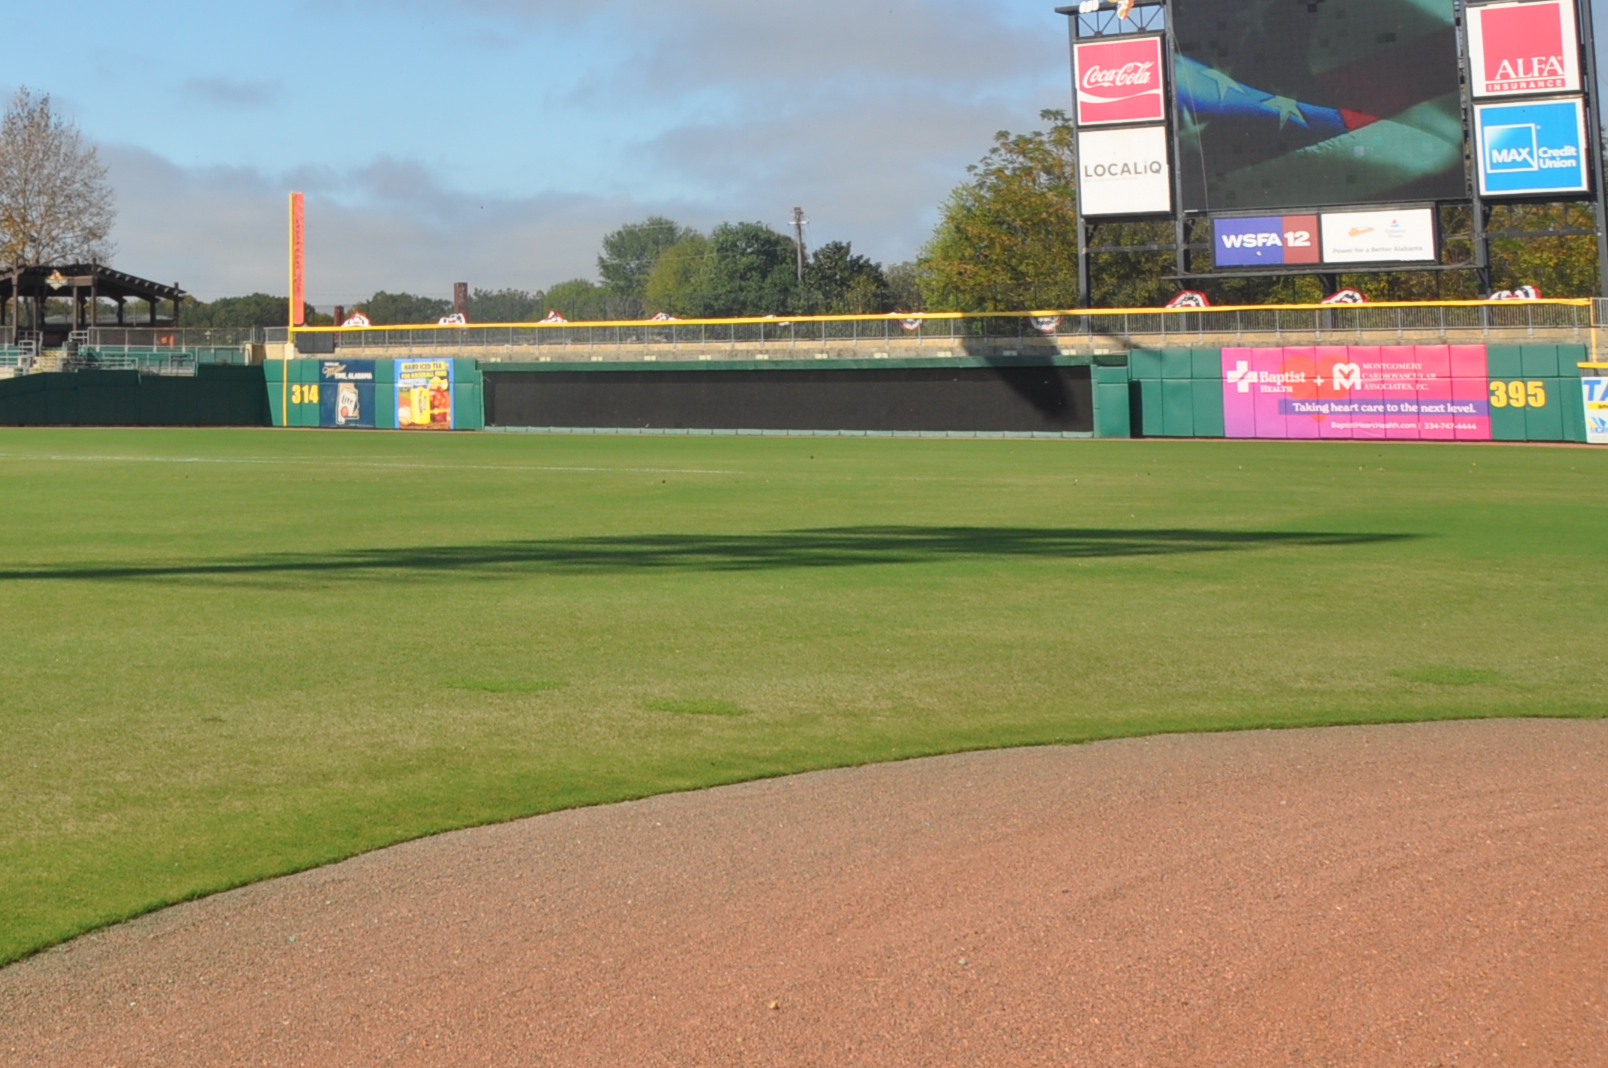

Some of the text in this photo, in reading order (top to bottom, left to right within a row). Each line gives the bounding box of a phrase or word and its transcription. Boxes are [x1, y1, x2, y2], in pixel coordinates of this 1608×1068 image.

[1494, 55, 1565, 81] ALFA
[1082, 61, 1155, 89] Coca-Cola
[1488, 80, 1562, 91] INSURANCE
[1492, 145, 1577, 164] MAX Credit
[1539, 157, 1577, 169] Union
[1221, 230, 1311, 248] WSFA 12
[1259, 371, 1306, 385] Baptist
[1362, 372, 1436, 380] CARDIOVASCULAR
[1364, 383, 1414, 391] ASSOCIATES,
[292, 384, 319, 404] 314
[341, 394, 353, 405] Lite
[1489, 381, 1546, 407] 395
[1293, 402, 1476, 414] Taking heart care to the next level.
[1331, 422, 1477, 430] BaptistHeartHealth.com 334-747-4444
